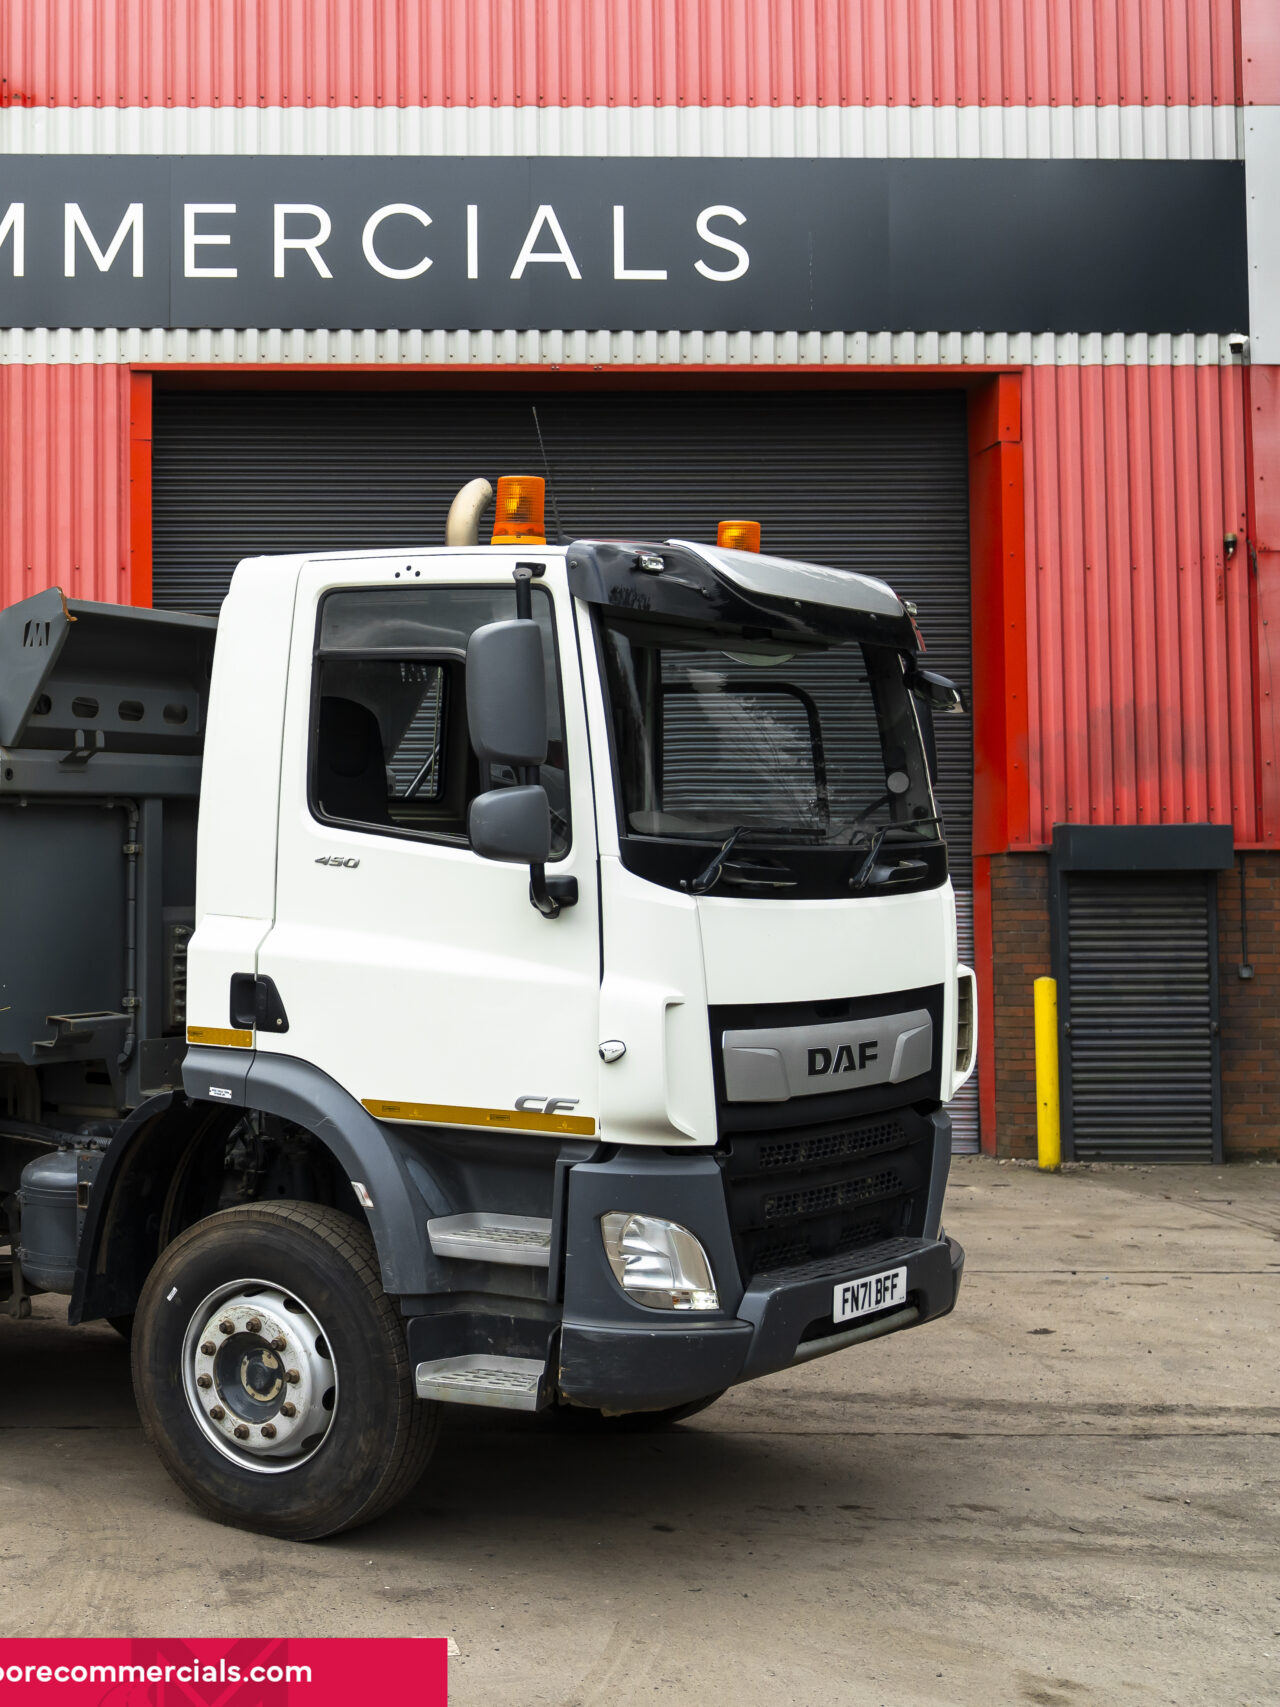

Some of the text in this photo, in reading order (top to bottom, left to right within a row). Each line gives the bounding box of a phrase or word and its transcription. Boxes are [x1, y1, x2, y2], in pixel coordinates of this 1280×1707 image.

[314, 855, 361, 869] 450
[807, 1040, 878, 1076] DAF
[514, 1095, 580, 1115] CF
[842, 1272, 899, 1316] FN71 BFF
